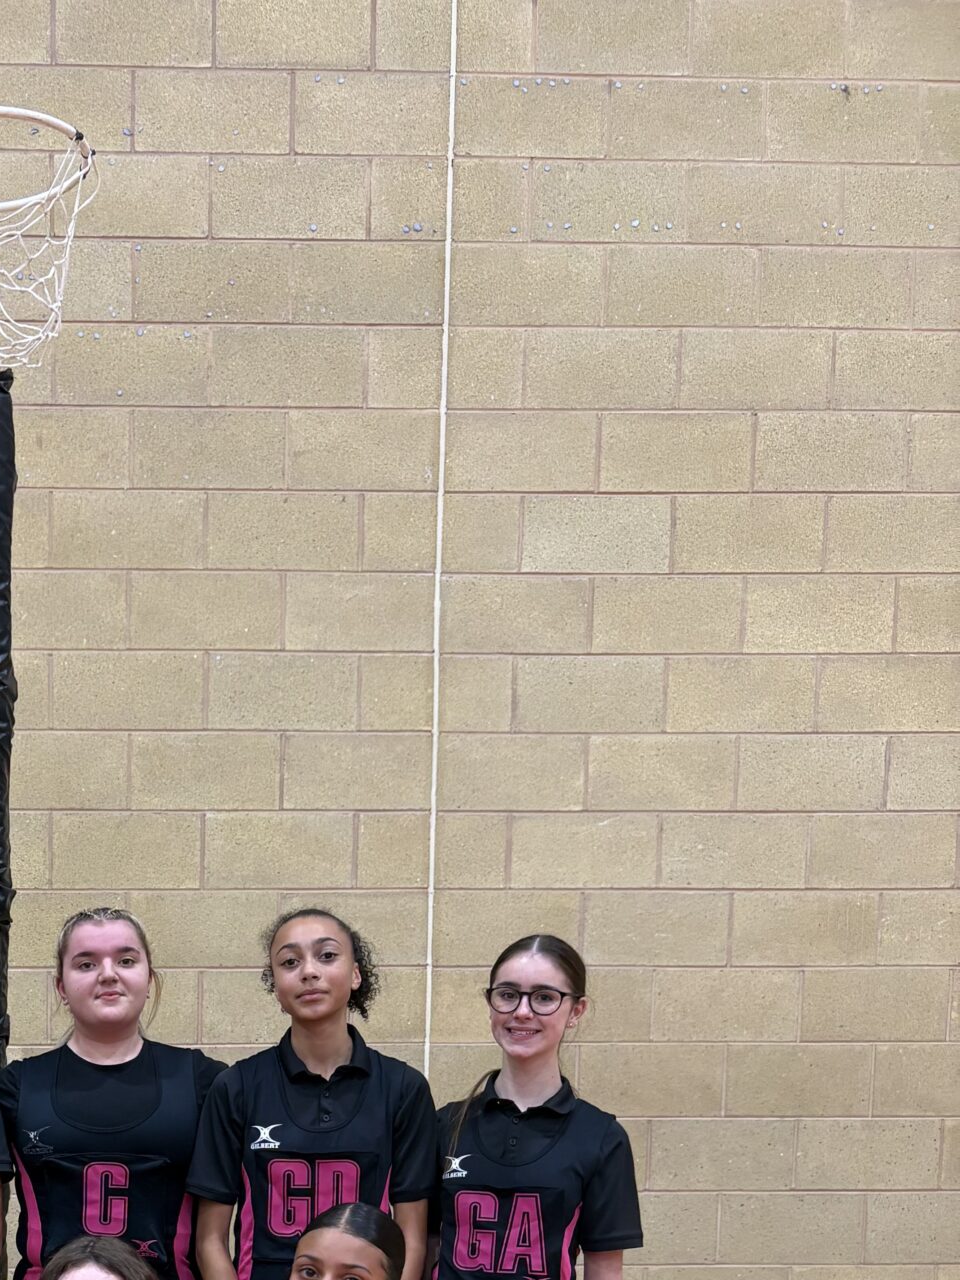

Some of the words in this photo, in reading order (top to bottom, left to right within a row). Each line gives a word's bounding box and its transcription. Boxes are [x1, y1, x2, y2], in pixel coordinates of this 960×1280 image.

[250, 1142, 281, 1150] GILBERT
[82, 1161, 130, 1237] C
[267, 1158, 361, 1237] GD
[452, 1190, 548, 1276] GA
